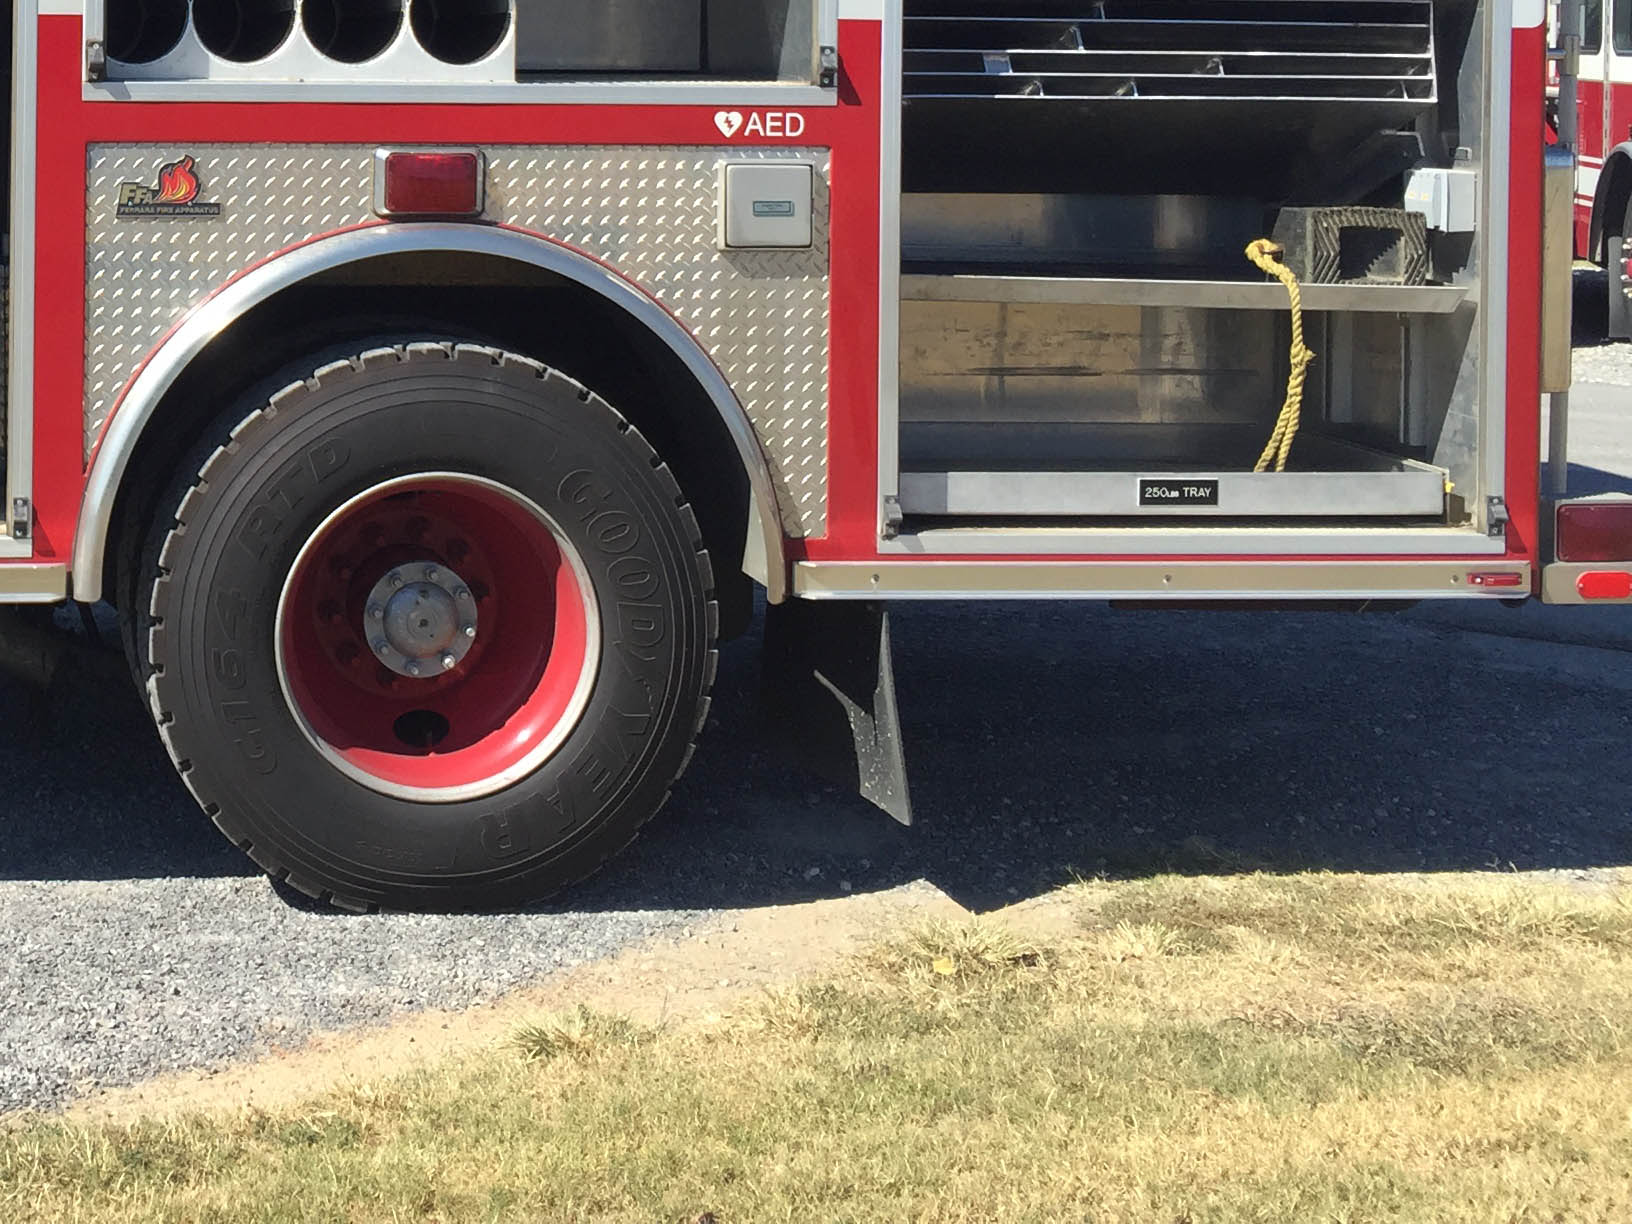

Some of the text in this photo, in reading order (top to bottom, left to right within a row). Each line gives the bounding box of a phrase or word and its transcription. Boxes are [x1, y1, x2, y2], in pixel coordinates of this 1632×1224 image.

[744, 112, 805, 137] AED
[1183, 487, 1212, 497] TRAY
[480, 468, 666, 860] GOODYEAR
